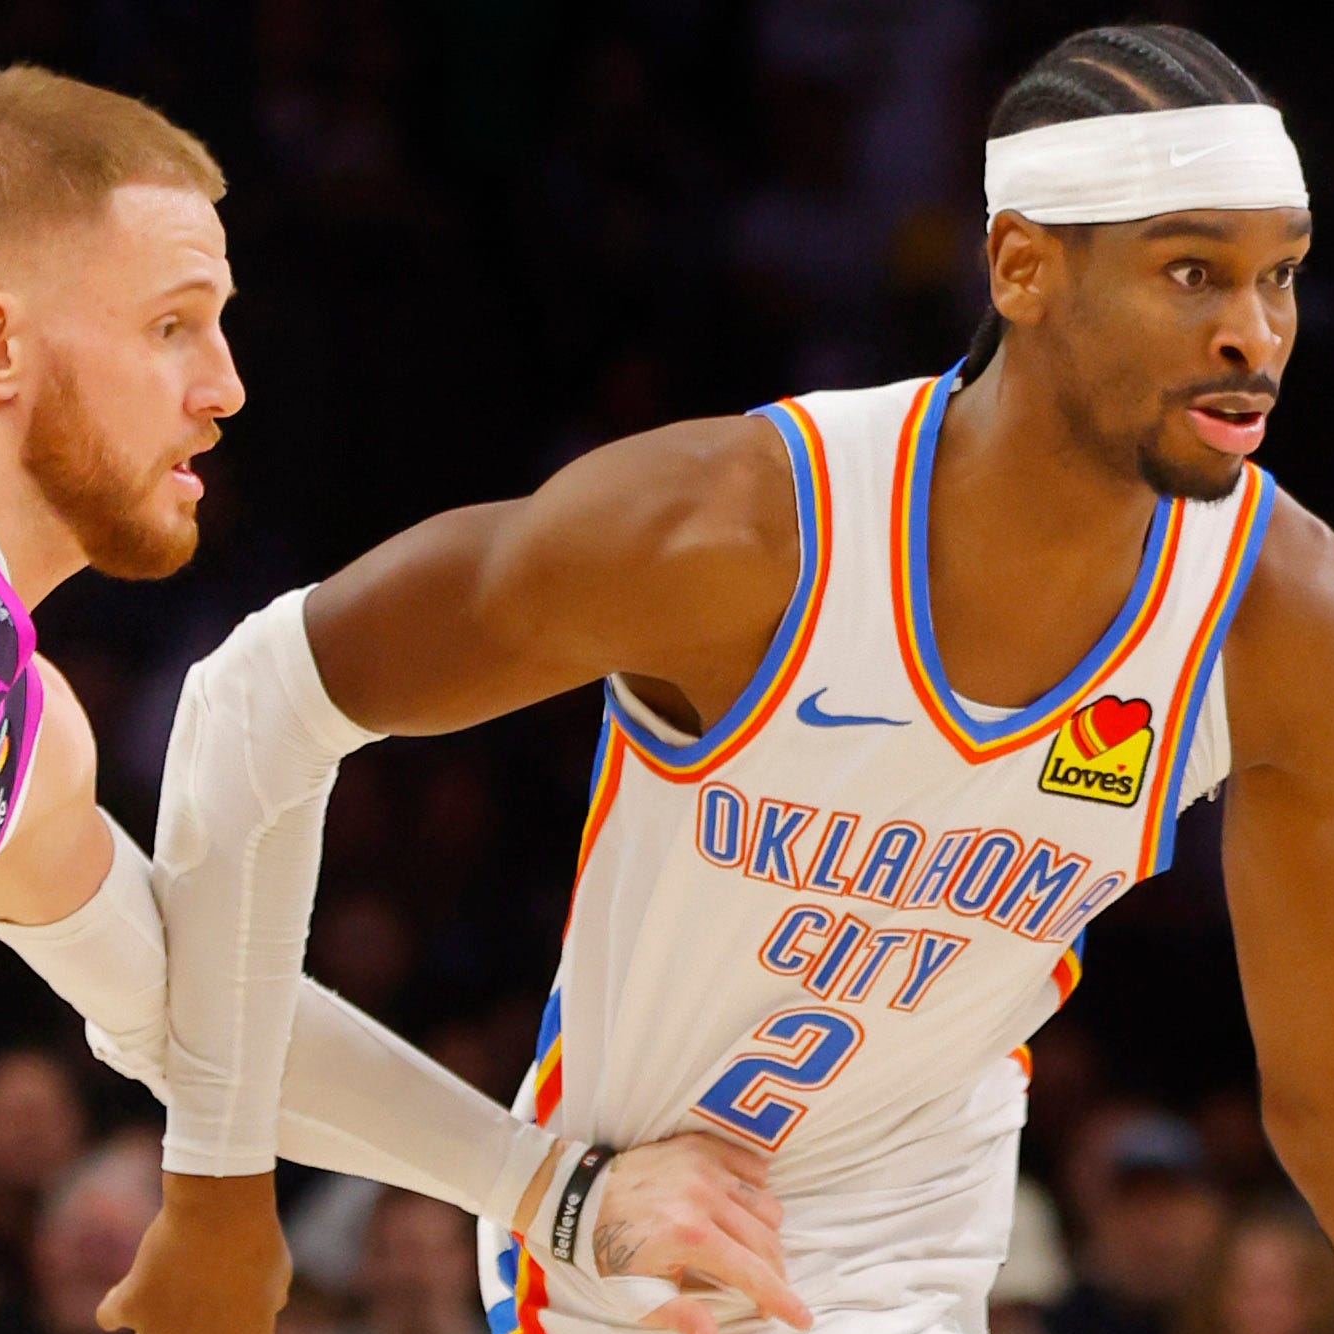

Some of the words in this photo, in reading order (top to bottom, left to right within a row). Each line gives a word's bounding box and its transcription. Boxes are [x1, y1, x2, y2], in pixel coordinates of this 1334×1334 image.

[759, 903, 971, 1012] CITY
[690, 1006, 865, 1153] 2
[553, 1192, 581, 1259] Believe
